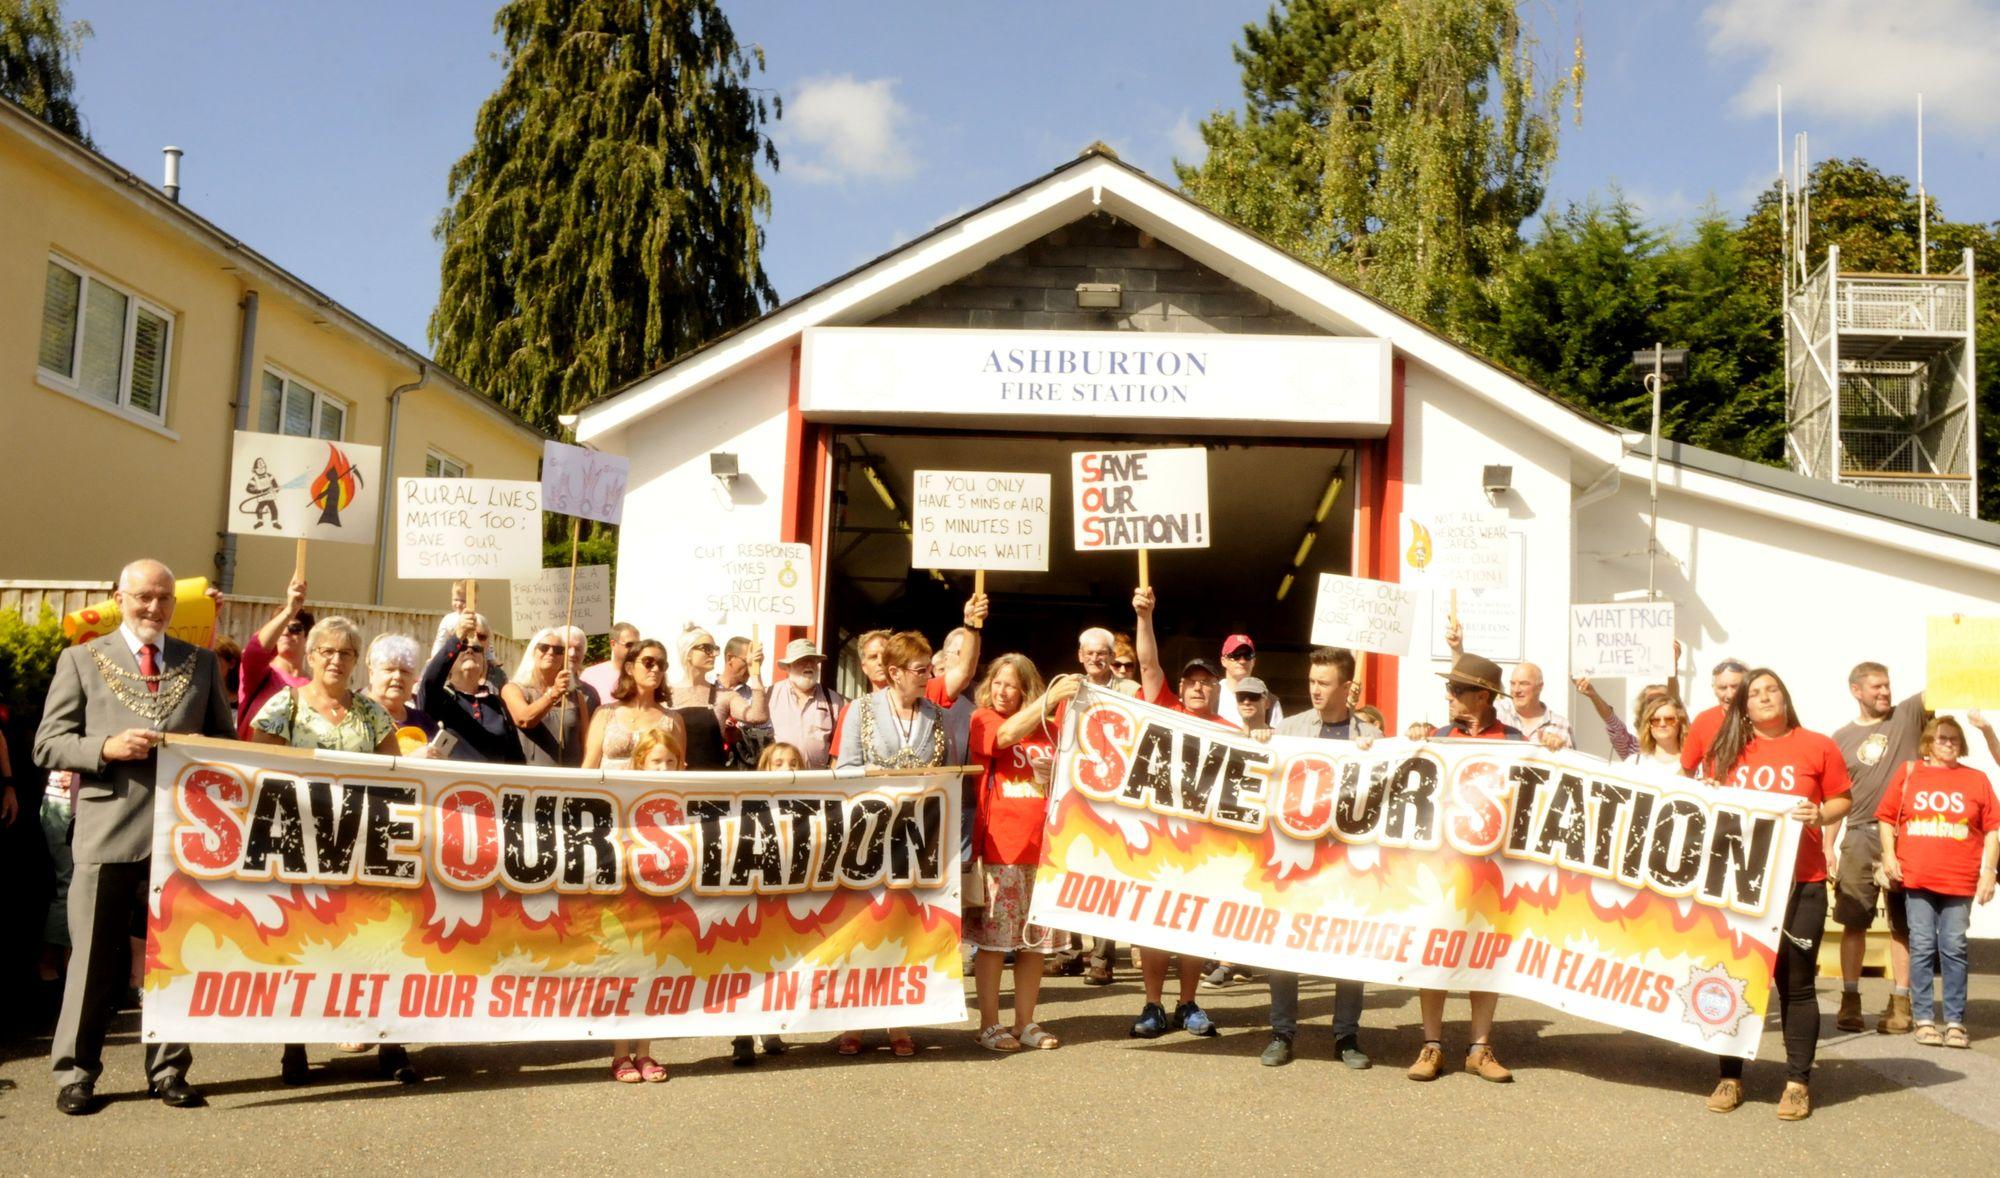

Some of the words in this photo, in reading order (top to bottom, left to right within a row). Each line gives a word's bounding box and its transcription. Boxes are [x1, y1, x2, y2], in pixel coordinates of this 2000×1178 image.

[981, 349, 1207, 376] ASHBURTON
[1001, 382, 1062, 401] FIRE
[1072, 384, 1187, 403] STATION
[1081, 452, 1148, 483] SAVE
[920, 475, 932, 489] IF
[945, 476, 976, 492] YOU
[986, 478, 1025, 493] ONLY
[405, 480, 478, 505] RURAL
[488, 486, 537, 511] LIVES
[918, 494, 951, 508] HAVE
[957, 494, 966, 509] 5
[1003, 500, 1016, 510] OF
[1082, 485, 1138, 514] OUR
[406, 510, 471, 529] MATTER
[920, 517, 935, 533] 15
[945, 518, 1009, 535] MINUTES
[1018, 519, 1033, 535] IS
[1082, 513, 1202, 546] STATION!
[405, 532, 445, 547] SAVE
[464, 535, 502, 551] OUR
[1479, 525, 1508, 540] WEAR
[418, 551, 498, 567] STATION!
[694, 545, 726, 558] CUT
[737, 544, 806, 560] RESPONSE
[929, 540, 941, 557] A
[949, 542, 986, 558] LONG
[721, 561, 768, 576] TIMES
[732, 577, 764, 593] NOT
[1323, 578, 1365, 597] LOSE
[1376, 584, 1410, 605] OUR
[549, 608, 593, 620] SHATER
[705, 594, 797, 615] SERVICES
[1339, 595, 1397, 617] STATION
[1318, 608, 1352, 625] LOSE
[1368, 616, 1403, 634] YOUR
[1575, 608, 1626, 629] WHAT
[1629, 608, 1673, 629] PRICE
[1577, 632, 1588, 647] A
[1596, 632, 1643, 647] RURAL
[1734, 765, 1795, 791] SOS
[1078, 708, 1269, 825] SAVE
[1284, 757, 1440, 842] OUR
[1454, 761, 1776, 906] STATION
[1913, 790, 1965, 813] SOS
[181, 769, 417, 878] SAVE
[440, 790, 616, 886] OUR
[633, 795, 941, 887] STATION
[1056, 870, 1153, 922] DON'T
[1153, 889, 1209, 933] LET
[1212, 900, 1281, 946] OUR
[1286, 912, 1416, 964] SERVICE
[1421, 928, 1468, 968] GO
[1468, 931, 1513, 970] UP
[1516, 939, 1551, 980] IN
[1552, 947, 1675, 1014] FLAMES
[188, 970, 315, 1018] DON'T
[322, 973, 389, 1018] LET
[398, 974, 479, 1018] OUR
[488, 975, 637, 1018] SERVICE
[644, 975, 697, 1016] GO
[703, 973, 751, 1015] UP
[762, 971, 800, 1011] IN
[809, 965, 928, 1010] FLAMES
